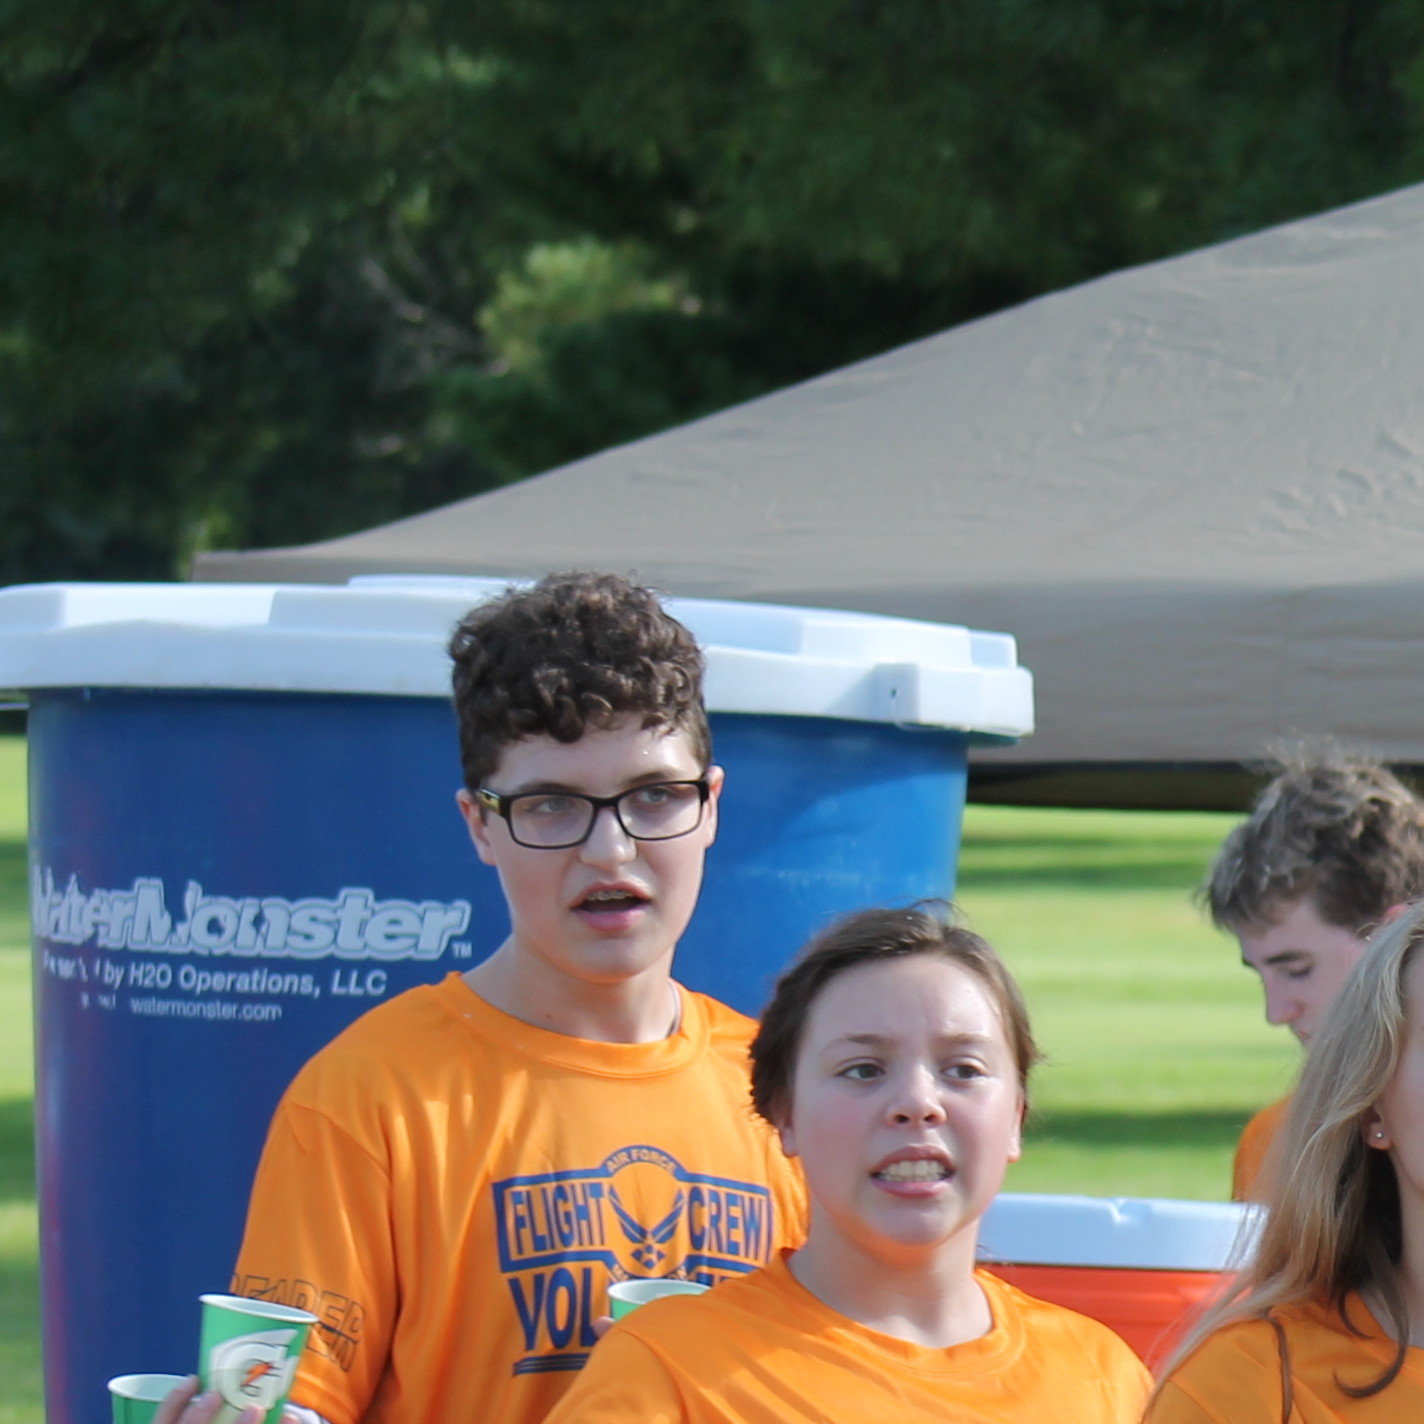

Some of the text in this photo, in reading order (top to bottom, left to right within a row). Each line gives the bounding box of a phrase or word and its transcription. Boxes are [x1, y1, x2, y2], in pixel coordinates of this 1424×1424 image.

[104, 960, 124, 989] by
[129, 961, 173, 988] H2O
[179, 964, 320, 998] Operations,
[331, 970, 388, 996] LLC
[605, 1149, 677, 1175] AIR FORCE
[511, 1182, 765, 1261] FLIGHT CREW
